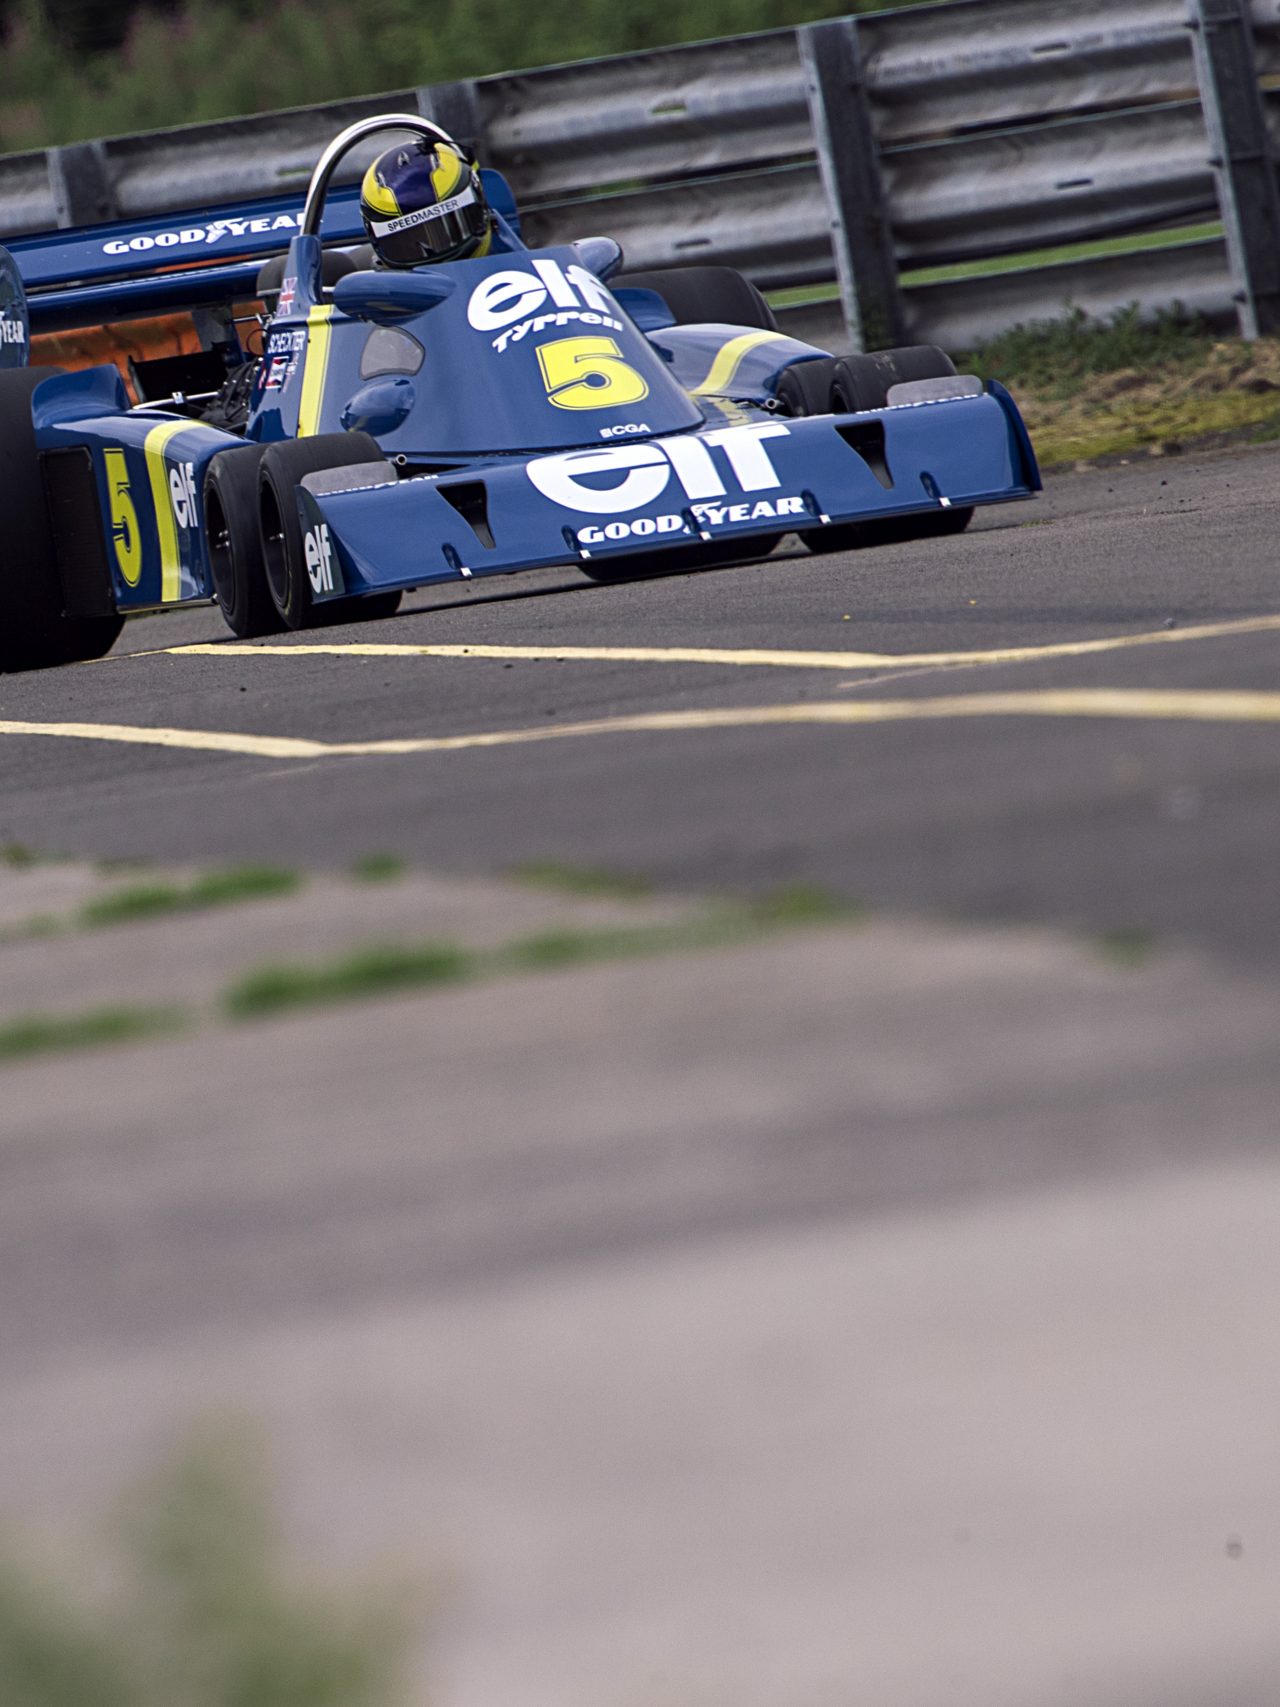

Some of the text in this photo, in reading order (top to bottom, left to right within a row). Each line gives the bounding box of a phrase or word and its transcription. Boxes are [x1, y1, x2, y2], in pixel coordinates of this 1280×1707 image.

[387, 199, 459, 232] SPEEDMASTER
[467, 259, 613, 332] elf
[535, 335, 650, 411] 5
[170, 462, 198, 529] elf
[526, 421, 791, 513] elf
[103, 448, 142, 587] 5
[304, 523, 334, 594] elf
